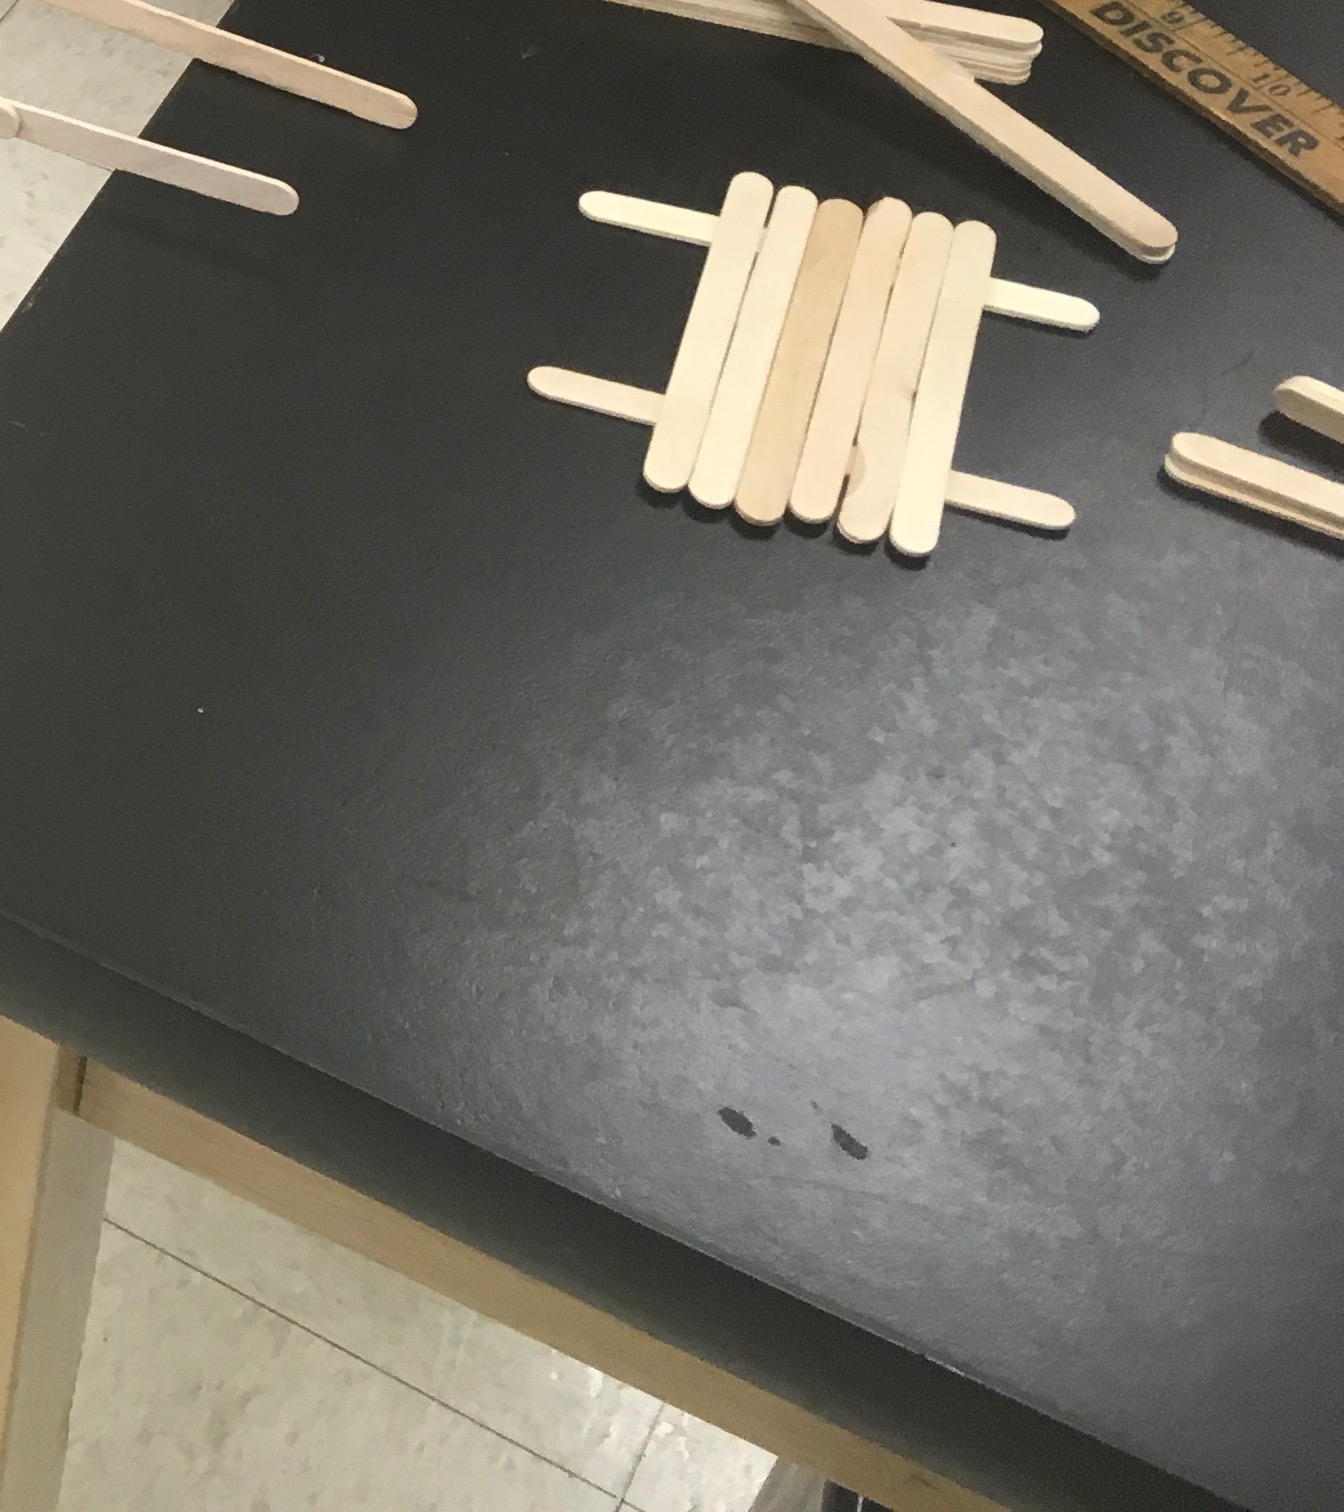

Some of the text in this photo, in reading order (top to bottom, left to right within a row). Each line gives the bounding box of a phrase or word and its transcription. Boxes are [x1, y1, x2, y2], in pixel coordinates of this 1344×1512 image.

[1162, 10, 1185, 25] 9
[1090, 1, 1321, 157] DISCOVER
[1252, 72, 1292, 98] 10
